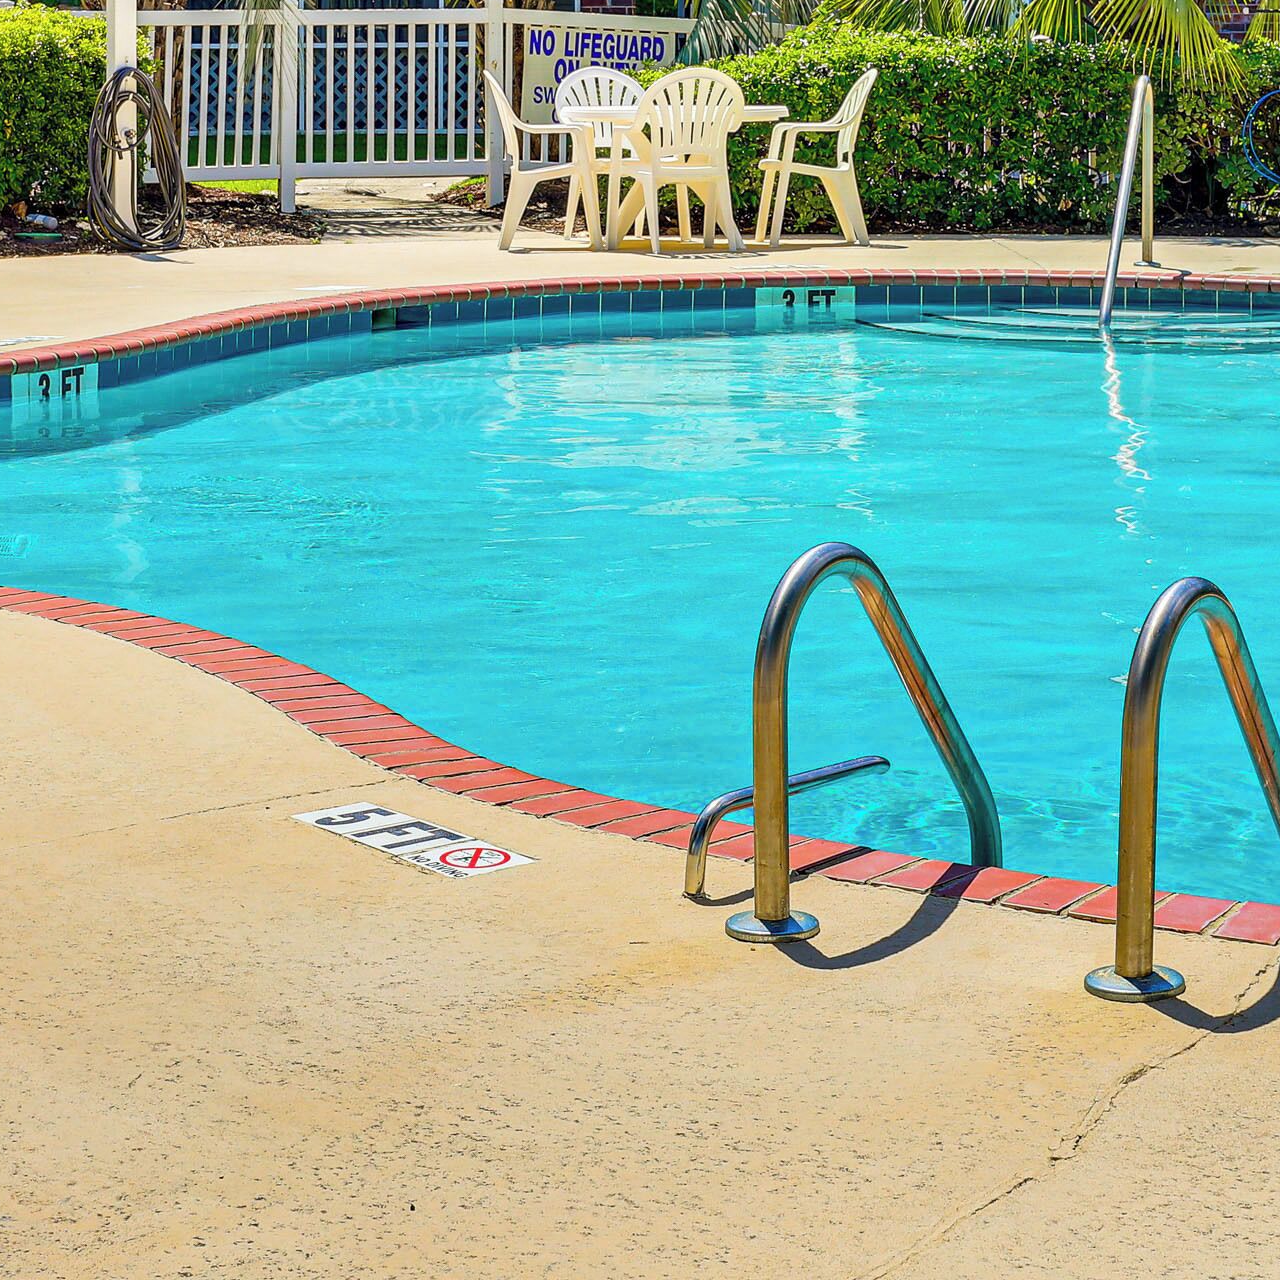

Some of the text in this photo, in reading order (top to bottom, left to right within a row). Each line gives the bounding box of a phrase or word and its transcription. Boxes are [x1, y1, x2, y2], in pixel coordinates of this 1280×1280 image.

[529, 29, 665, 62] NO LIFEGUARD
[533, 86, 557, 105] SW
[38, 367, 85, 402] 3 FT
[315, 807, 468, 850] 5 FT
[407, 854, 469, 878] NO DIVING
